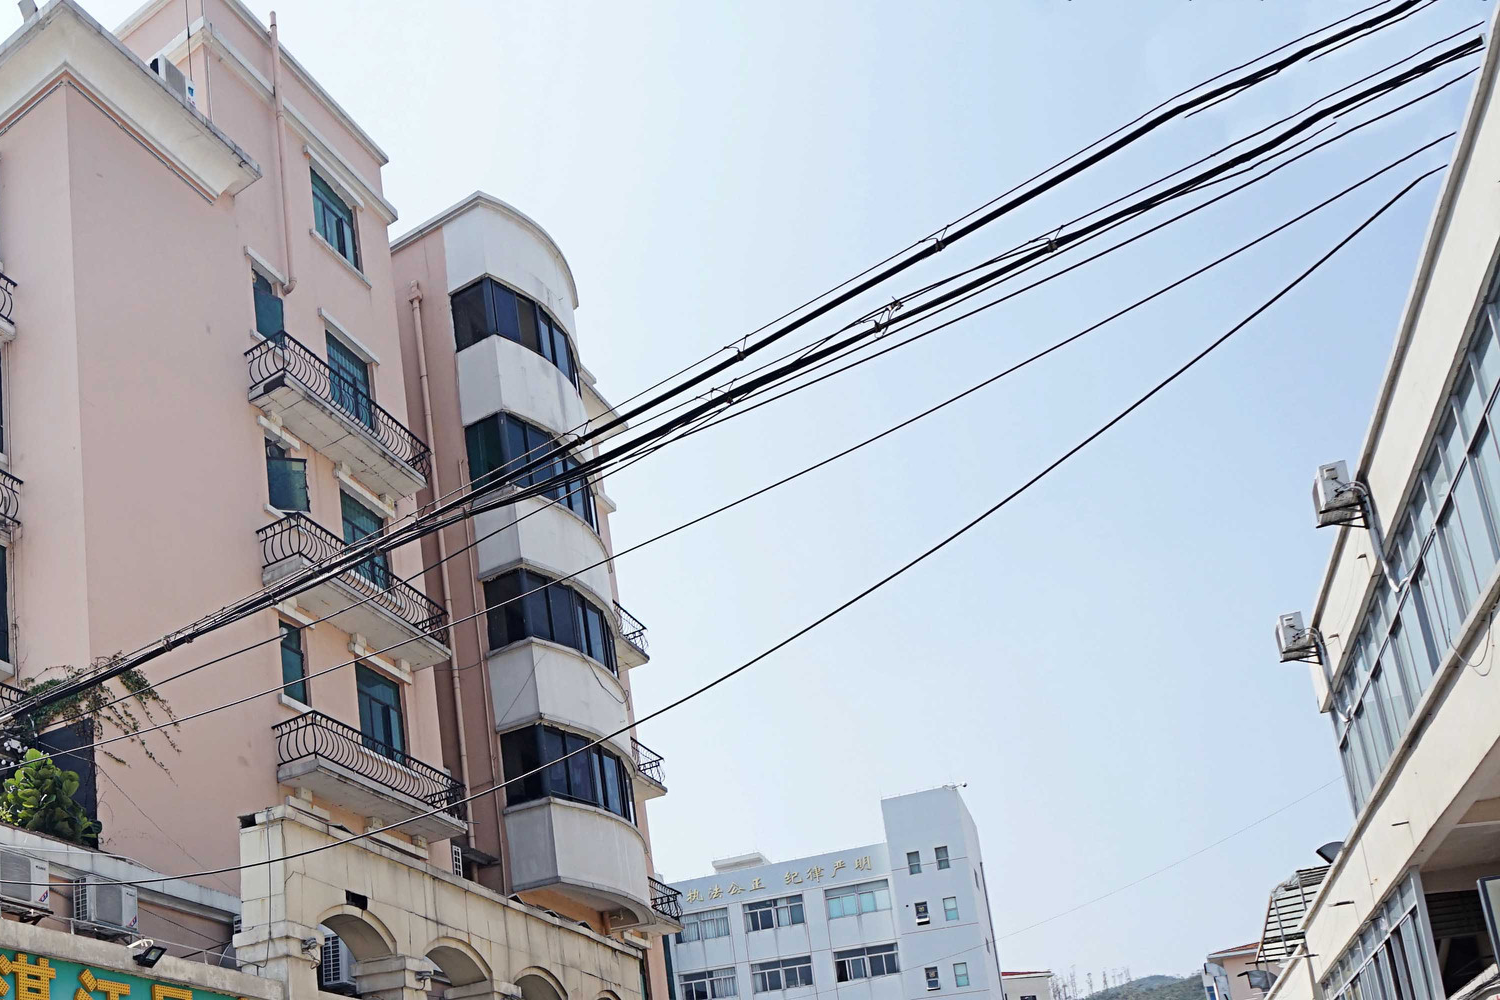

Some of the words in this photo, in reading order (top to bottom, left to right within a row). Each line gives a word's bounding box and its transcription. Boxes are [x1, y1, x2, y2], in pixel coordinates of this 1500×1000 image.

[686, 877, 766, 904] 执法公正
[784, 855, 873, 885] 纪律严明
